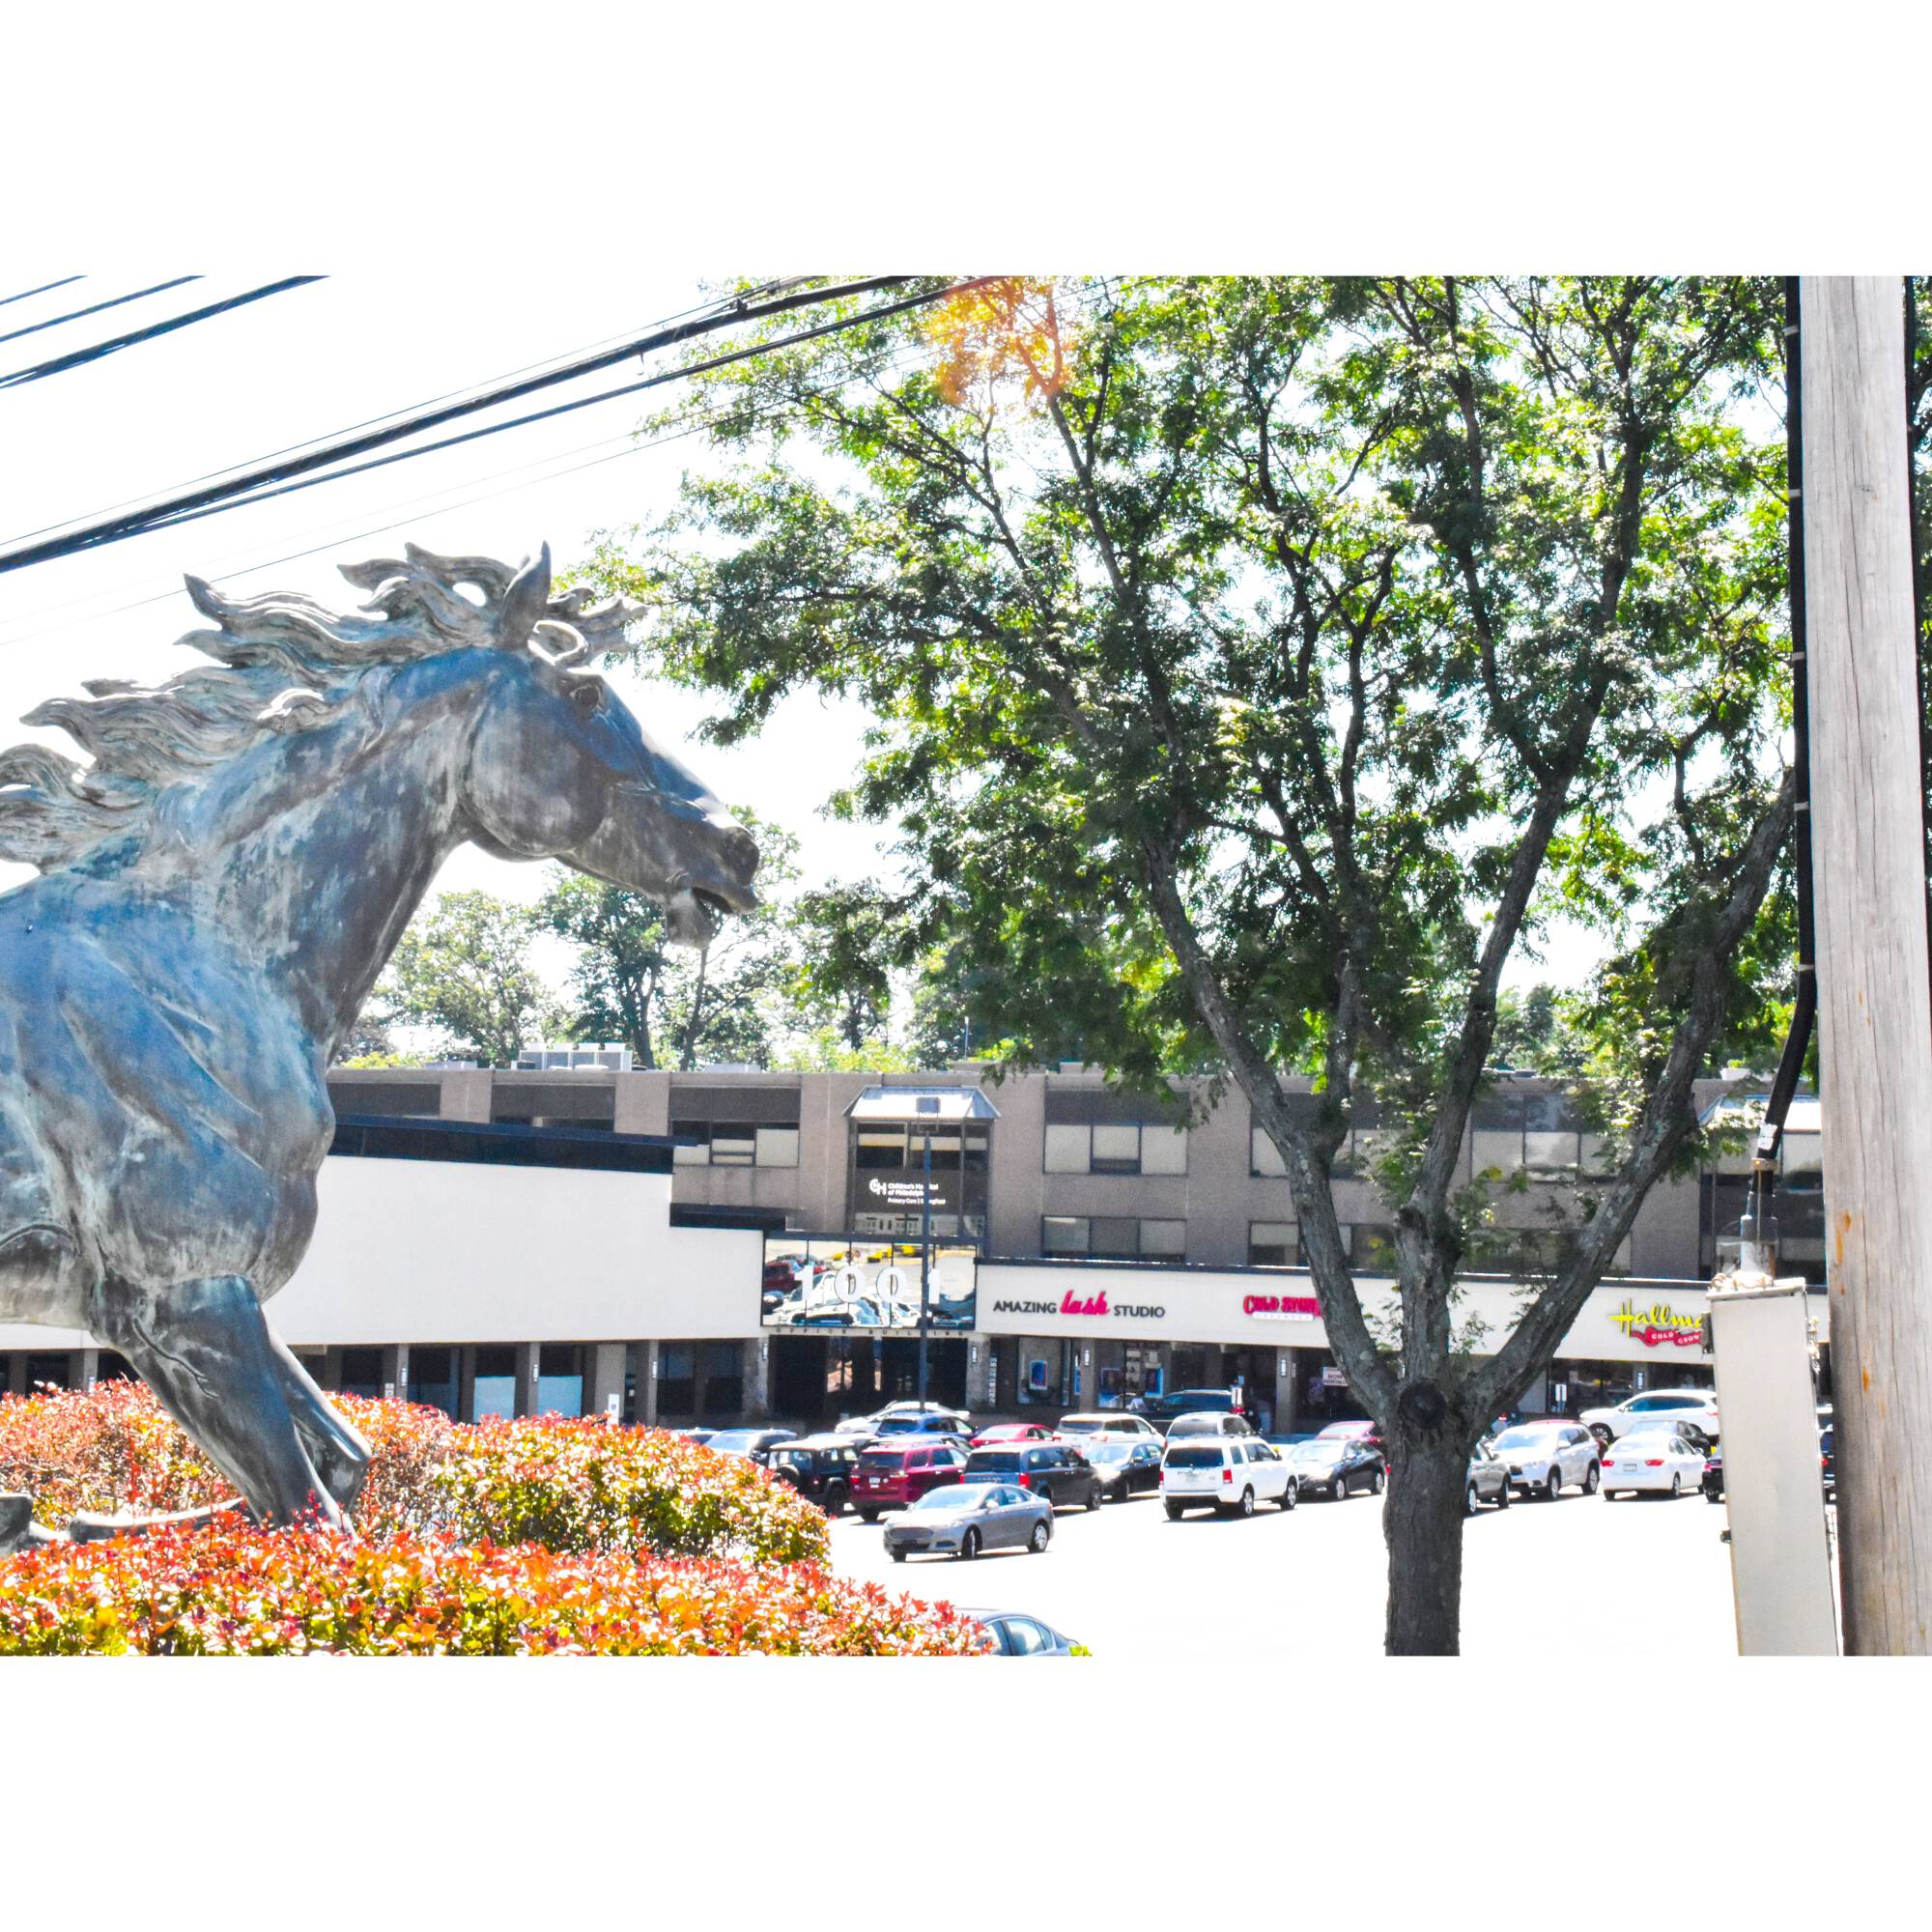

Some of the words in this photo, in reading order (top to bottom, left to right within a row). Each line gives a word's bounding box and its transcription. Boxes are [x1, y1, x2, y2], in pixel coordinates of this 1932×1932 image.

[794, 1264, 941, 1304] 1001
[993, 1300, 1057, 1314] AMAZING
[1060, 1290, 1111, 1315] lash
[1114, 1305, 1165, 1318] STUDIO
[1243, 1294, 1279, 1314] COLD
[1607, 1298, 1703, 1337] Hallma
[1652, 1331, 1675, 1340] GOLD
[1678, 1334, 1700, 1345] CROW
